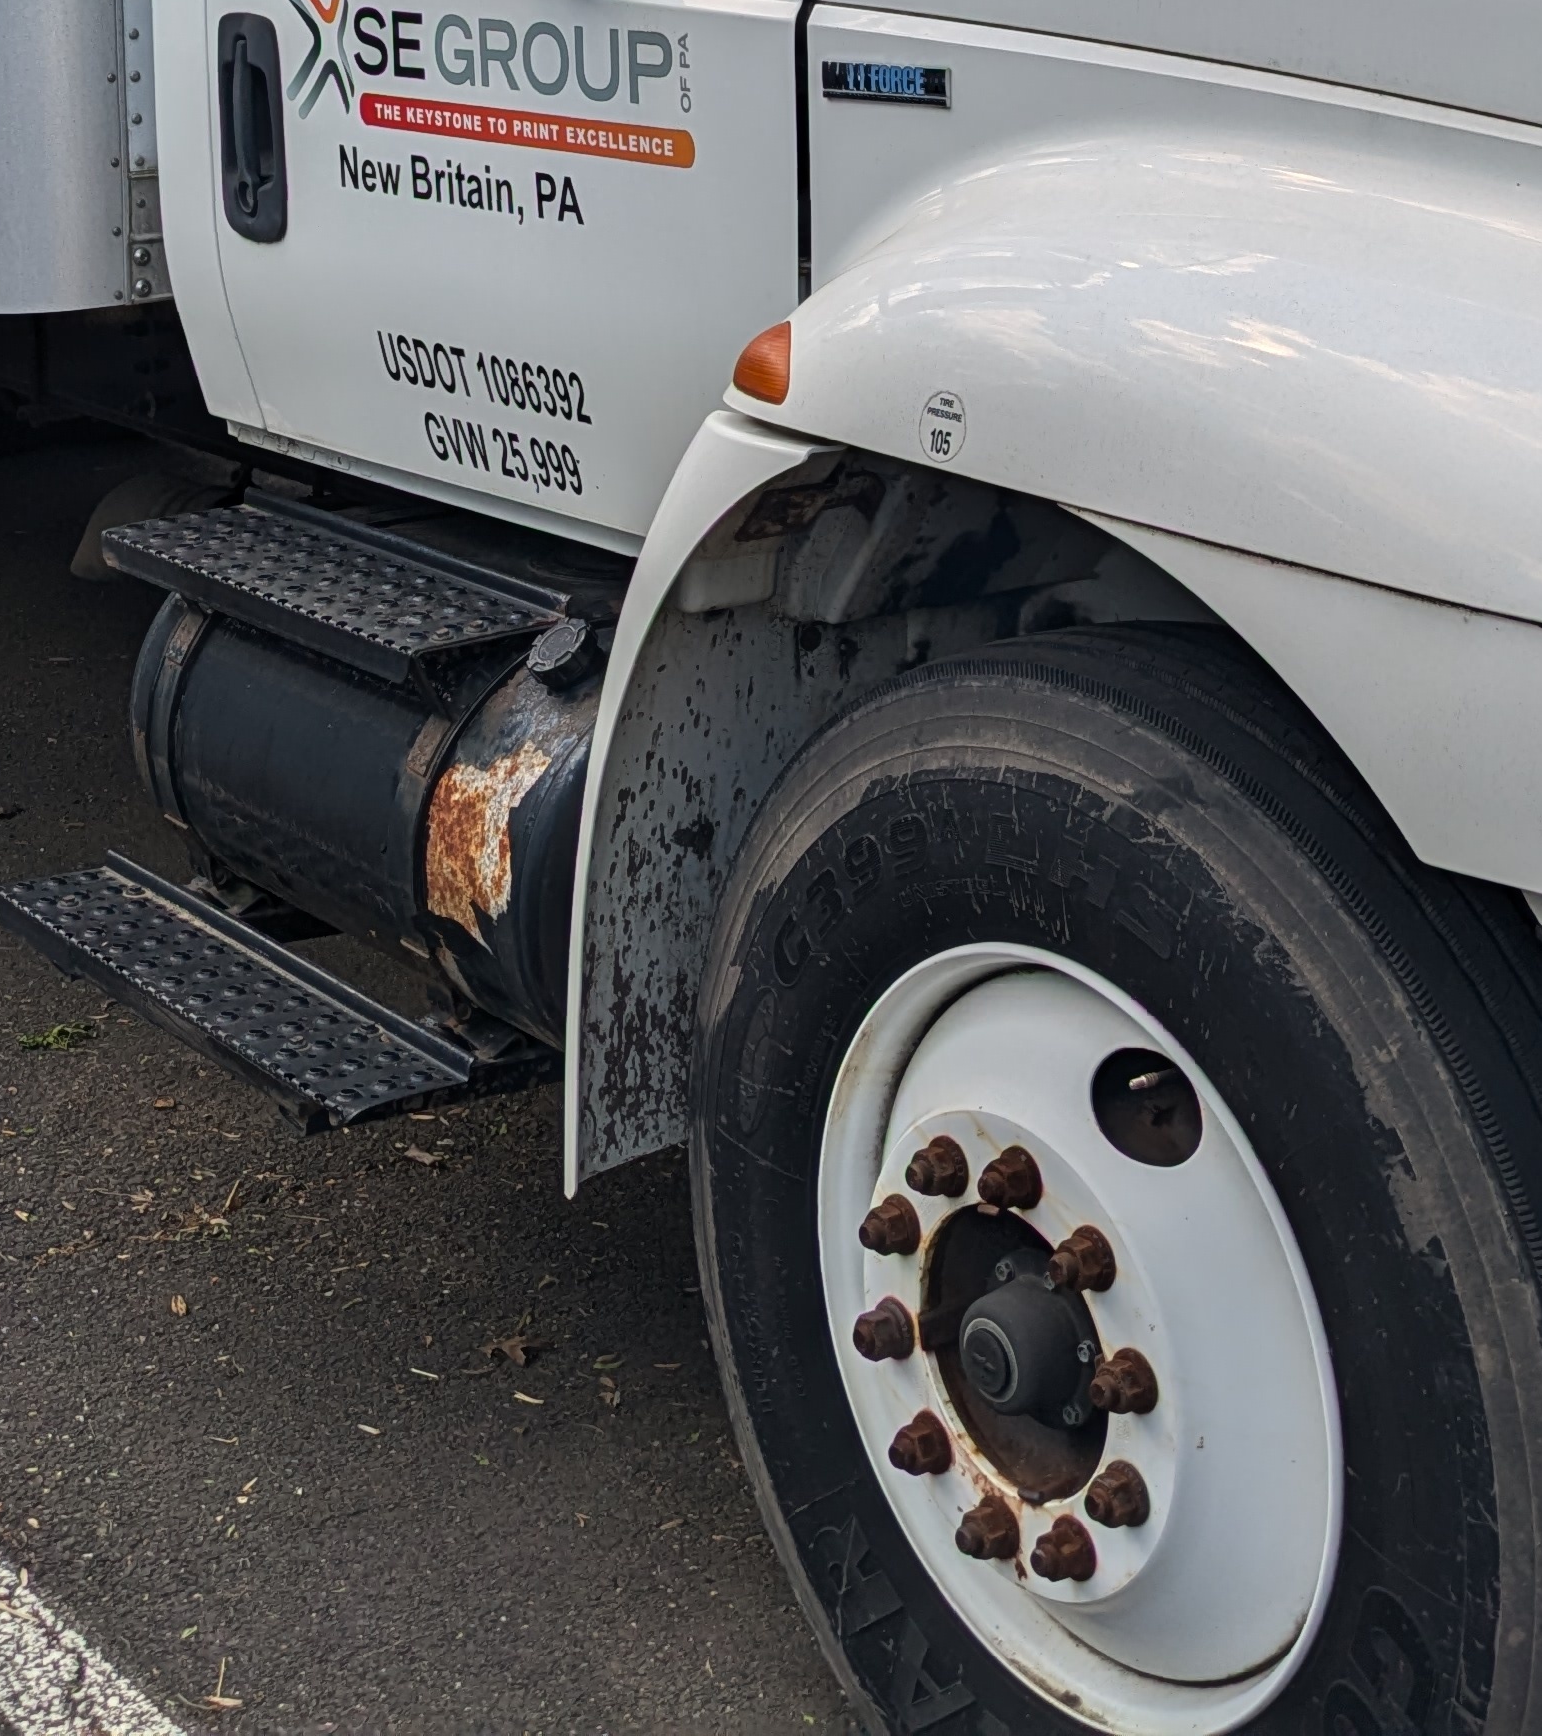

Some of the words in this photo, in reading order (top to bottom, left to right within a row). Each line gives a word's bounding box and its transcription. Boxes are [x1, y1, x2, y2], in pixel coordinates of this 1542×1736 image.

[677, 33, 690, 70] PA
[679, 75, 692, 114] OF
[374, 102, 402, 122] THE
[405, 106, 483, 133] KEYSTONE
[487, 116, 508, 136] TO
[513, 120, 560, 143] PRINT
[565, 126, 675, 158] EXCELLENCE
[339, 143, 401, 196] New
[410, 154, 525, 226] Britain,
[535, 171, 585, 225] PA
[376, 329, 472, 398] USDOT
[476, 351, 593, 425] 1086392
[926, 406, 963, 423] PRESSURE
[940, 397, 955, 409] TIRE
[424, 411, 491, 473] GVW
[492, 427, 584, 496] 25,999
[930, 427, 952, 456] 105
